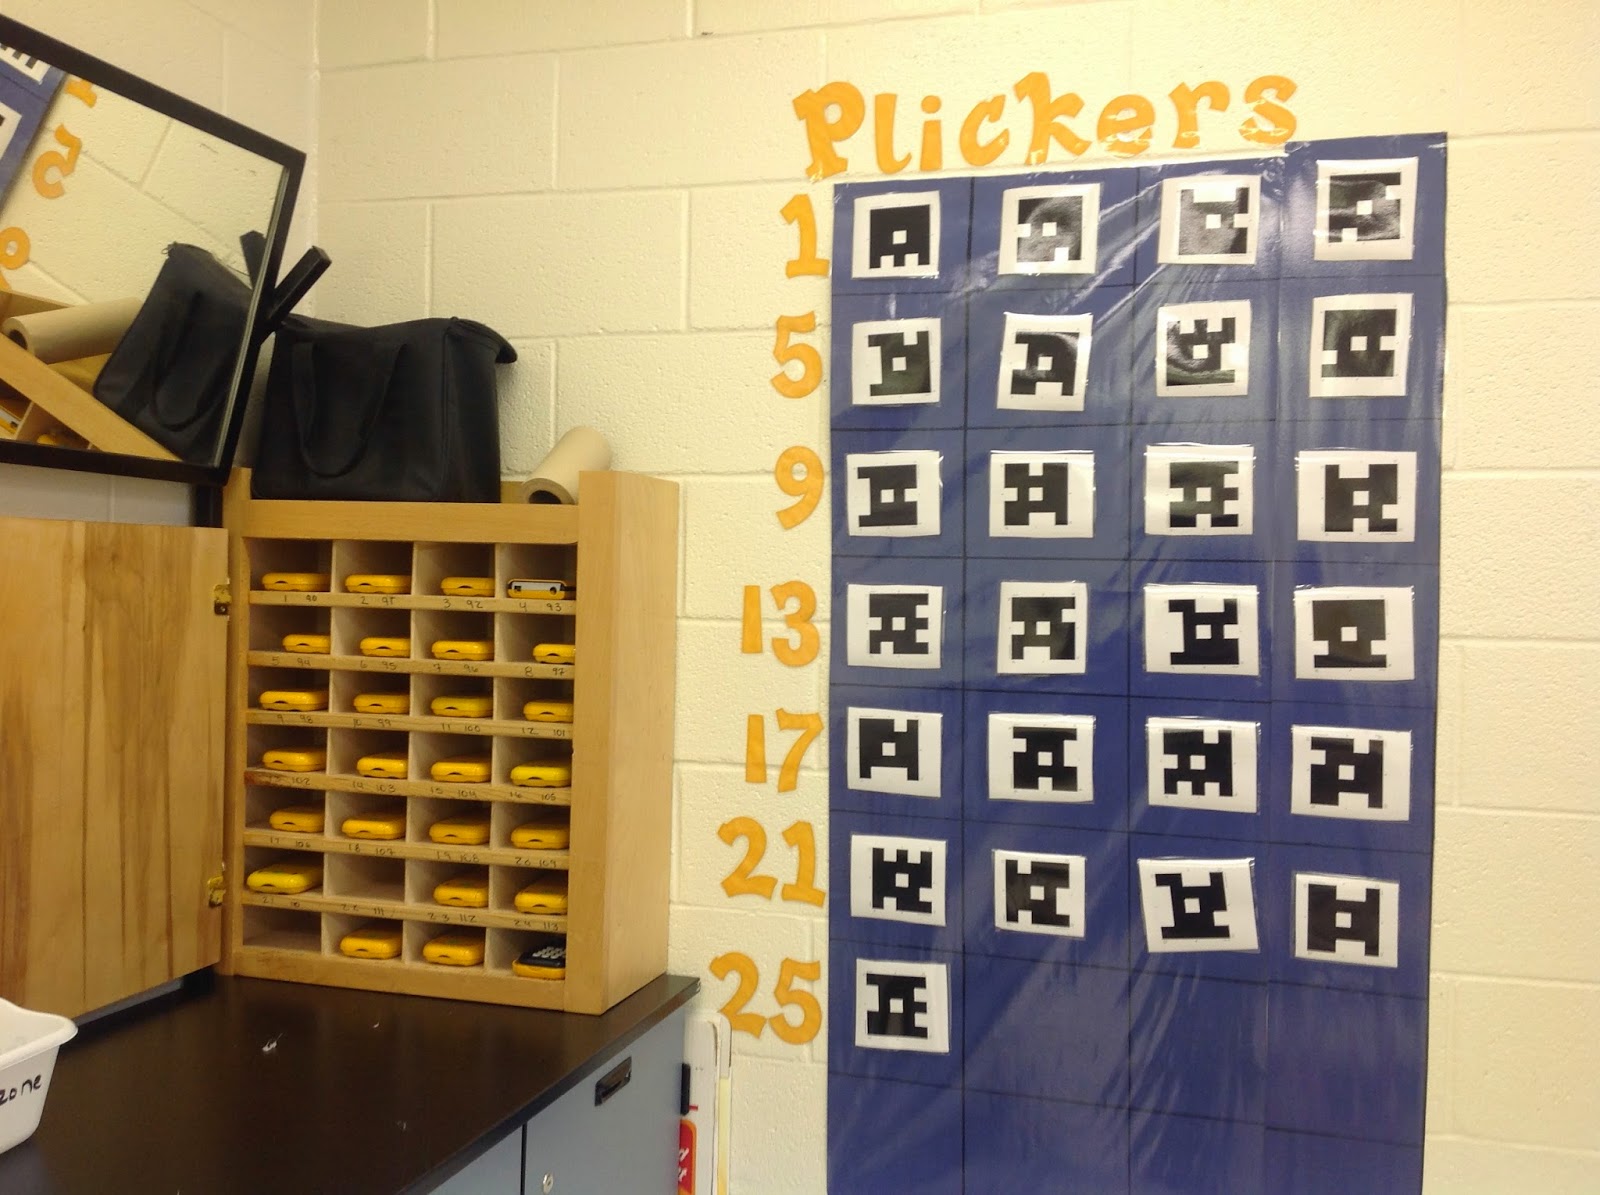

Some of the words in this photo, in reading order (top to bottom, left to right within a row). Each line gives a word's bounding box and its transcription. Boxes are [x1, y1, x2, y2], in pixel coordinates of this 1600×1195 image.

[793, 72, 1297, 180] Plickers
[780, 193, 830, 279] 1
[770, 310, 823, 399] 5
[773, 445, 825, 530] 9
[360, 596, 369, 605] 2
[443, 598, 451, 609] 3
[466, 599, 484, 610] 92
[546, 603, 562, 612] 93
[740, 580, 821, 668] 13
[271, 656, 280, 666] 5
[433, 663, 442, 673] 7
[524, 665, 533, 677] 8
[552, 667, 566, 676] 97
[276, 713, 284, 724] 9
[377, 718, 391, 728] 99
[464, 725, 481, 733] 100
[521, 727, 539, 736] 12
[553, 728, 566, 737] 101
[744, 707, 825, 793] 17
[716, 815, 827, 908] 21
[459, 913, 478, 923] 112
[543, 921, 559, 932] 113
[708, 950, 823, 1045] 25
